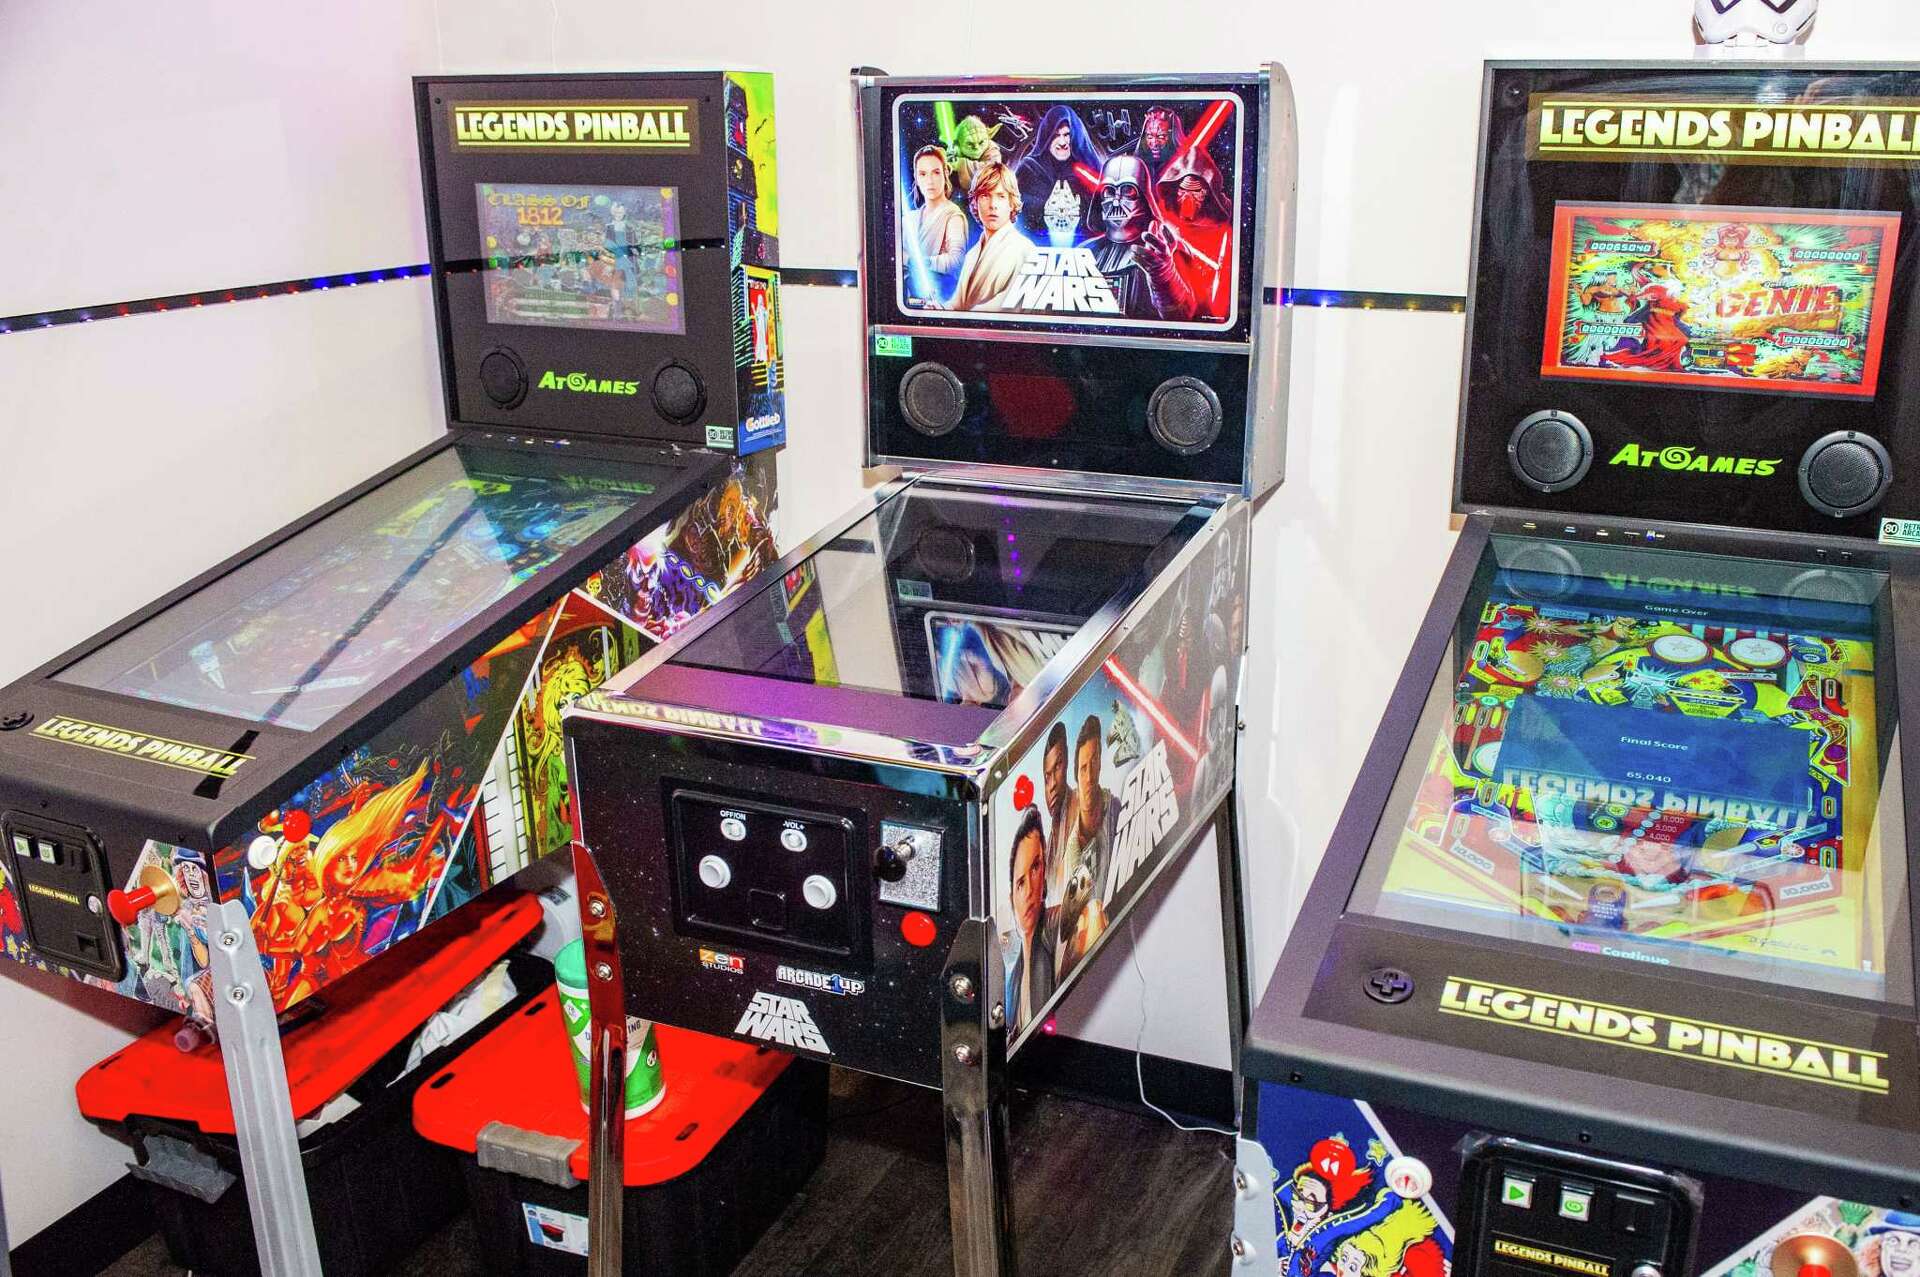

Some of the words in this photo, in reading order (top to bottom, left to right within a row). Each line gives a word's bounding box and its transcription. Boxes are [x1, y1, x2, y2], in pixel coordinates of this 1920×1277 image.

[456, 112, 569, 141] LEGENDS
[574, 111, 690, 141] PINBALL
[1540, 109, 1732, 148] LEGENDS
[1742, 110, 1920, 152] PINBAL
[517, 207, 565, 225] 1812
[1022, 247, 1103, 278] STAR
[1000, 275, 1120, 314] WARS
[1716, 285, 1839, 318] GENIE
[1884, 523, 1898, 534] 80
[1644, 604, 1679, 614] Game
[1681, 608, 1709, 617] Over
[34, 717, 143, 752] LEGENDS
[141, 740, 247, 776] PINBALL
[1620, 735, 1652, 747] Final
[1653, 739, 1689, 751] Score
[1116, 739, 1172, 833] STAR
[1625, 770, 1672, 784] 65,040
[720, 810, 746, 821] OFF/ON
[1102, 775, 1180, 910] WARS
[701, 961, 744, 975] STUDIOS
[1602, 947, 1670, 966] Continue
[748, 991, 817, 1026] STAR
[734, 1009, 831, 1055] WARS
[1443, 980, 1657, 1045] LEGENDS
[1667, 1021, 1890, 1087] PINBALL
[1494, 1239, 1552, 1263] LEGENDS
[1553, 1254, 1610, 1277] PINBALL
